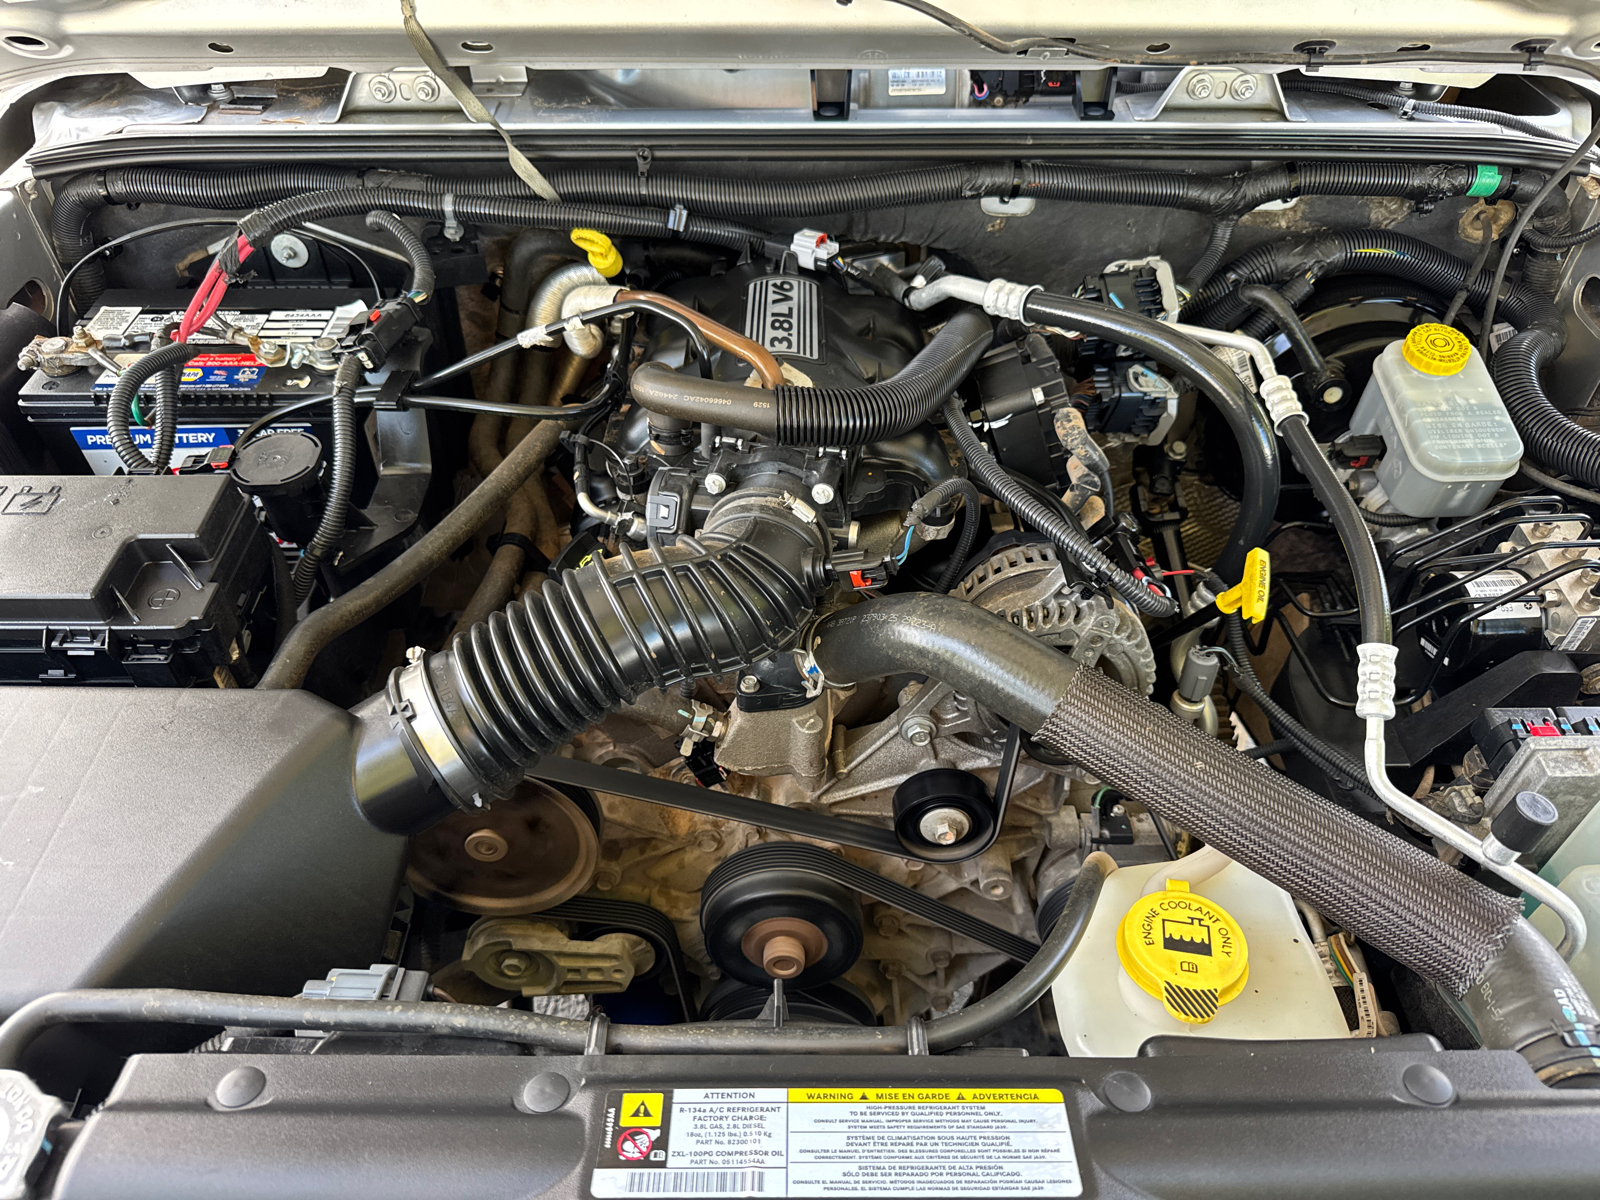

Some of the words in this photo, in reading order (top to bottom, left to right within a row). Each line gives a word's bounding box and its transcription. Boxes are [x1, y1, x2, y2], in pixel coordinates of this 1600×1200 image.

[1142, 908, 1160, 946] ENGINE
[1160, 901, 1221, 924] COOLANT
[1218, 928, 1232, 958] ONLY
[806, 1092, 854, 1100] WARNING
[876, 1092, 900, 1100] MISE
